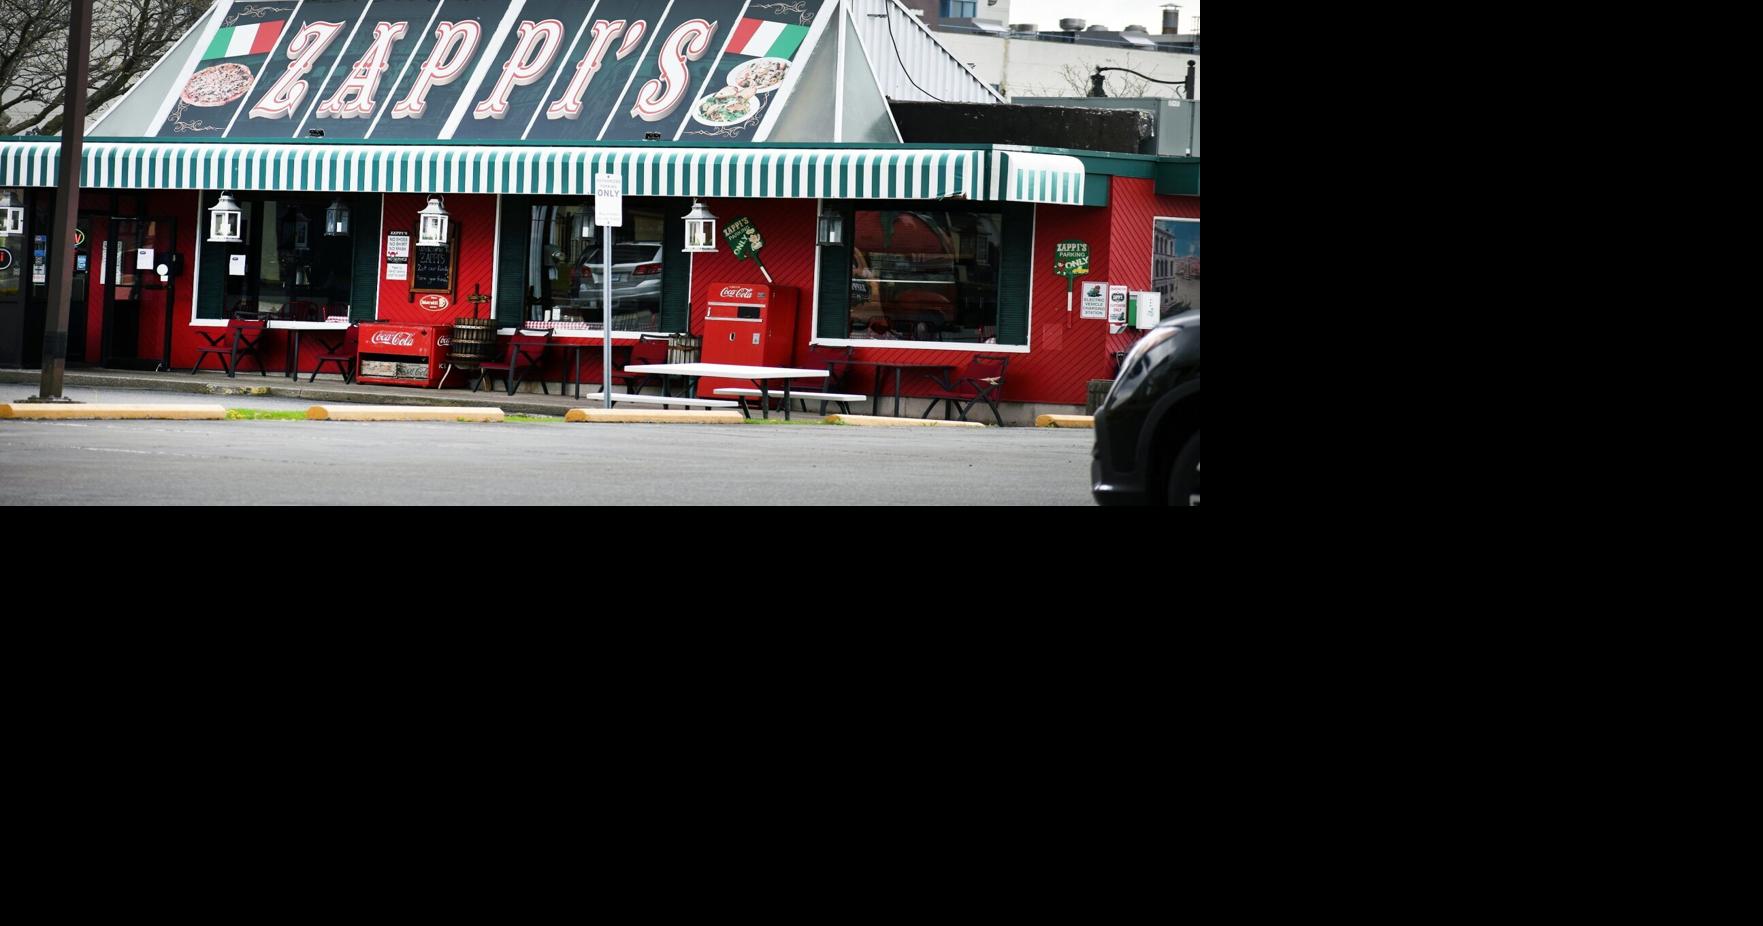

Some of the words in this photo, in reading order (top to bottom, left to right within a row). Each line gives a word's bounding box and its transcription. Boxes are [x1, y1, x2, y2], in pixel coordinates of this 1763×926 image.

[249, 19, 718, 121] ZAPPI'S
[597, 189, 620, 197] ONLY
[723, 217, 749, 236] ZAPPI'S
[728, 225, 750, 240] PARKING
[733, 234, 748, 255] ONLY
[1056, 243, 1087, 251] ZAPPI'S
[1065, 256, 1089, 269] ONLY
